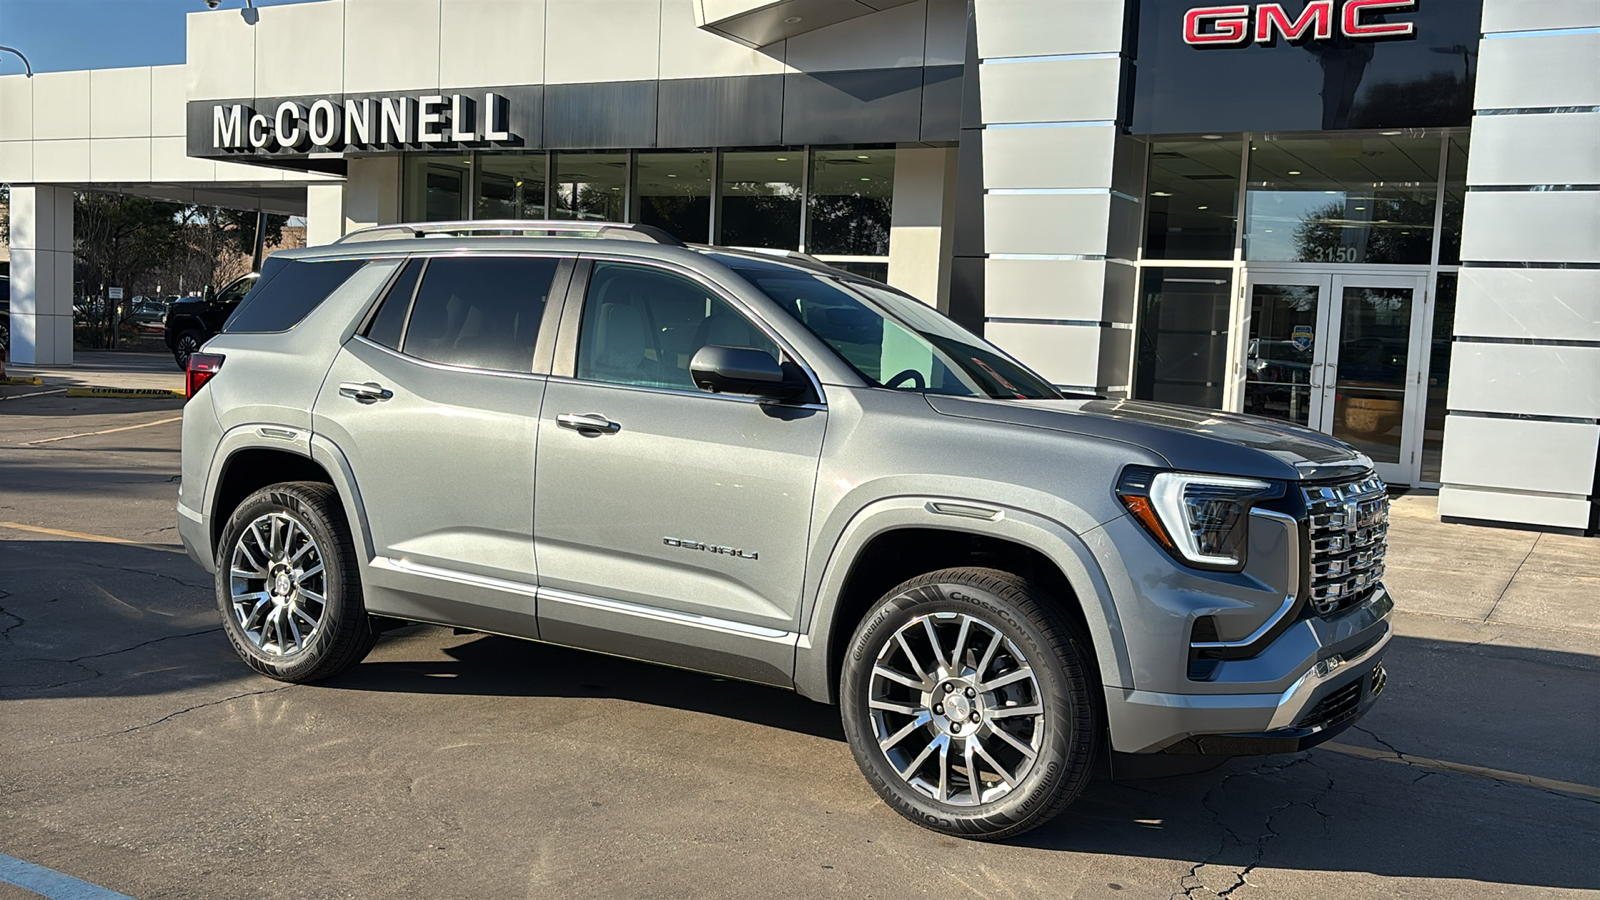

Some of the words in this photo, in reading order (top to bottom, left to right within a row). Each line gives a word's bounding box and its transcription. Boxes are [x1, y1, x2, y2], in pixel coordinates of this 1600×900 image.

[1183, 0, 1416, 45] GMC
[1313, 246, 1357, 263] 3150
[91, 387, 134, 395] CUSTOMER
[136, 388, 173, 396] PARKING
[662, 536, 758, 561] DENALI
[853, 612, 887, 662] Continental
[1020, 760, 1060, 812] Continental
